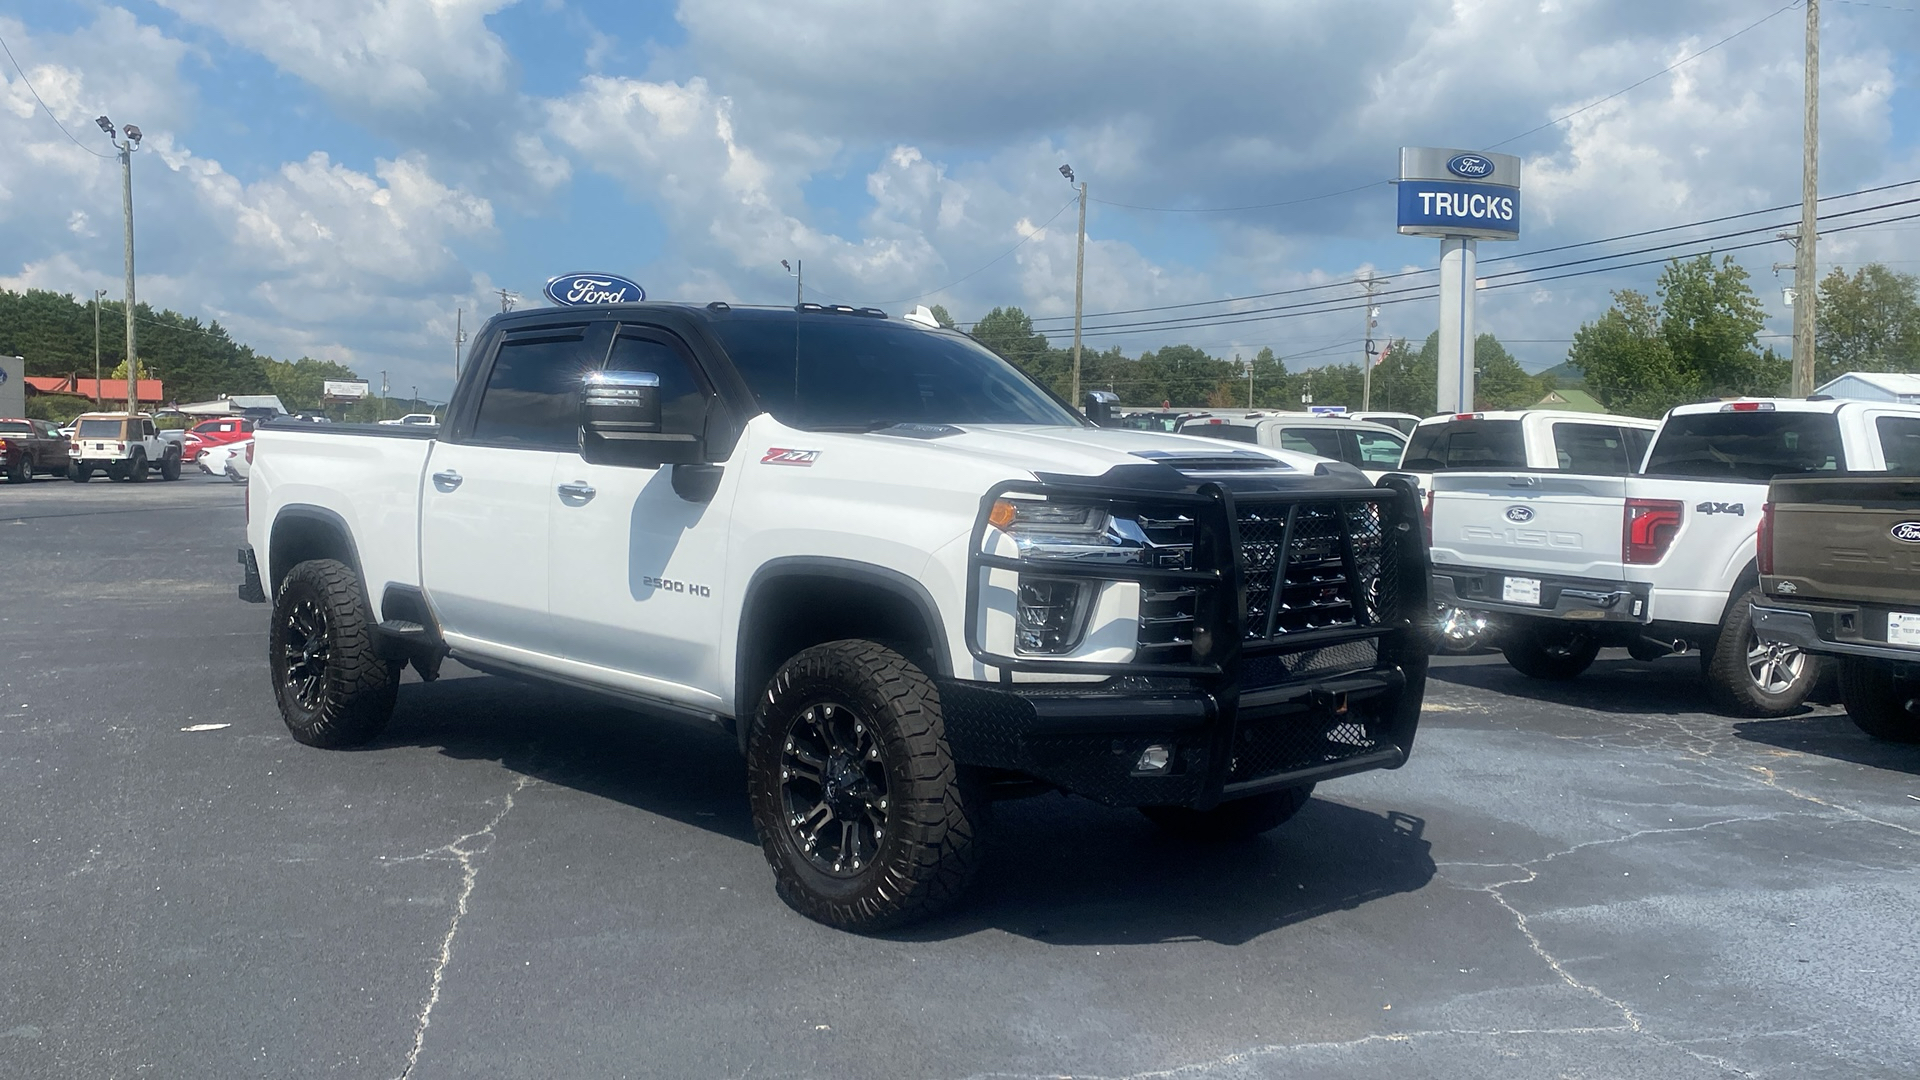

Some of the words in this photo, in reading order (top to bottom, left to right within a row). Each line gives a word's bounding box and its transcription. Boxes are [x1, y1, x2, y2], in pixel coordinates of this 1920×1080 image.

[1459, 157, 1486, 174] Ford
[1418, 192, 1513, 221] TRUCKS
[567, 278, 626, 304] Ford
[760, 447, 822, 467] Z71
[1509, 508, 1530, 521] Ford
[1460, 525, 1583, 549] F-150
[1898, 524, 1920, 539] For
[643, 575, 684, 593] 2500
[689, 583, 711, 598] HD
